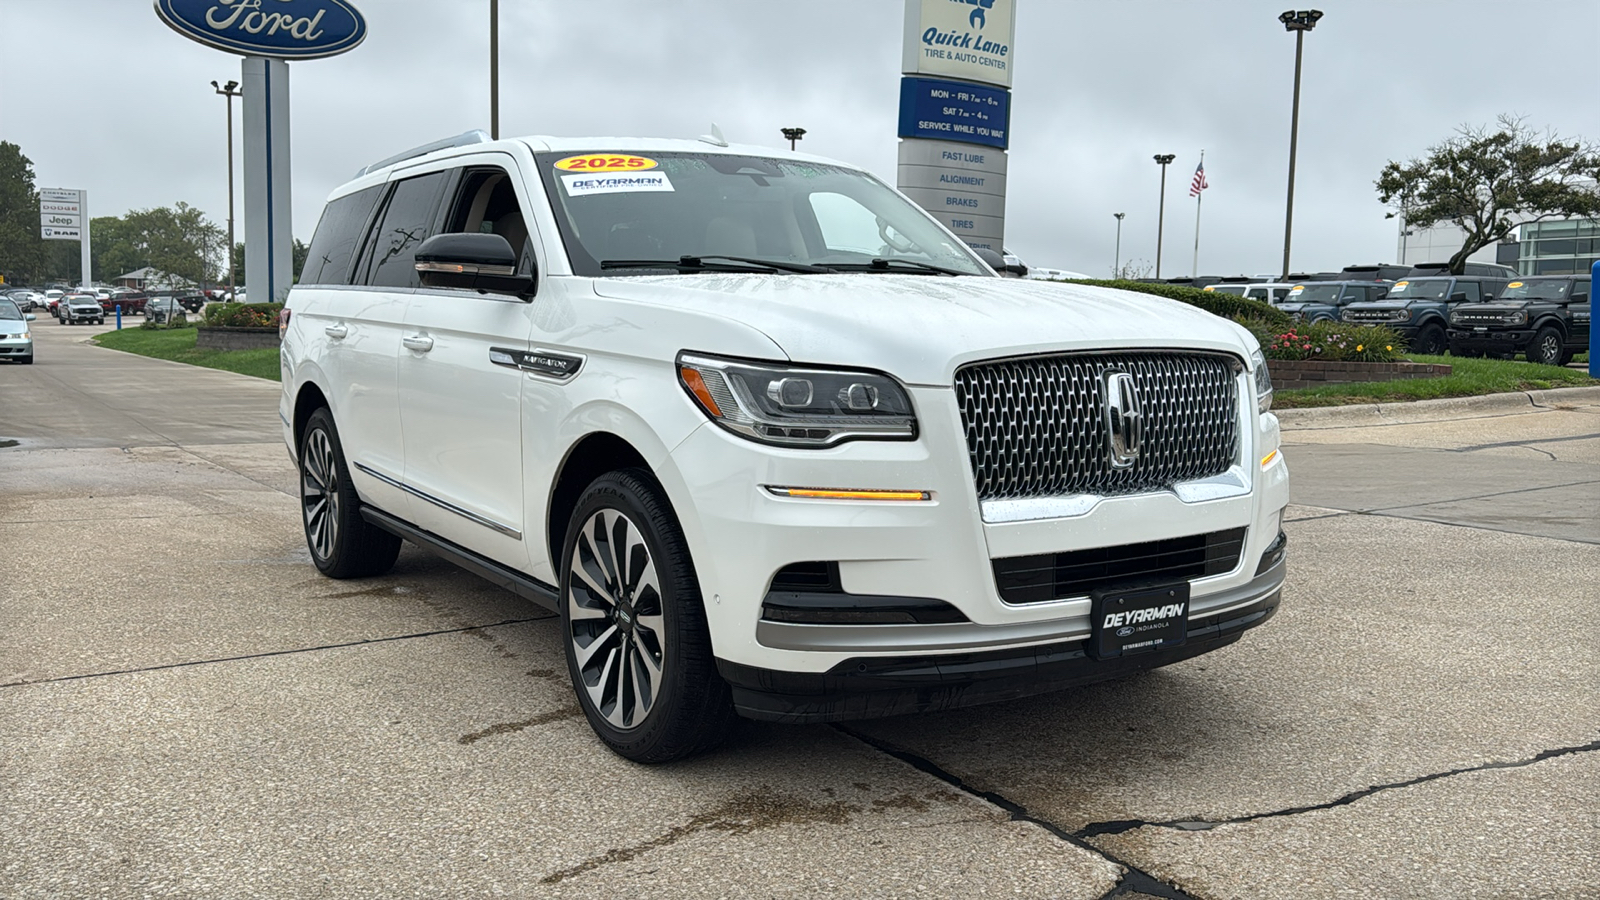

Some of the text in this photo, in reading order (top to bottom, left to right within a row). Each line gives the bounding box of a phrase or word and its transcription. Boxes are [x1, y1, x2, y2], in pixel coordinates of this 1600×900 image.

[205, 0, 327, 41] Ford
[922, 27, 1008, 56] Quick Lane
[924, 48, 1006, 70] TIRE & AUTO CENTER
[931, 89, 949, 99] MON
[957, 92, 969, 101] FRI
[942, 107, 957, 115] SAT
[918, 121, 1004, 139] SERVICE WHILE YOU WAIT
[568, 157, 645, 169] 2025
[942, 151, 985, 164] FAST LUBE
[573, 178, 662, 188] DEYARMAN
[940, 174, 985, 186] ALIGNMENT
[946, 197, 979, 208] BRAKES
[49, 216, 73, 225] Jeep
[951, 219, 974, 229] TIRES
[523, 355, 567, 369] NAVIGATOR
[1103, 602, 1185, 629] DEYARMAN
[1136, 621, 1169, 632] INDIANOLA
